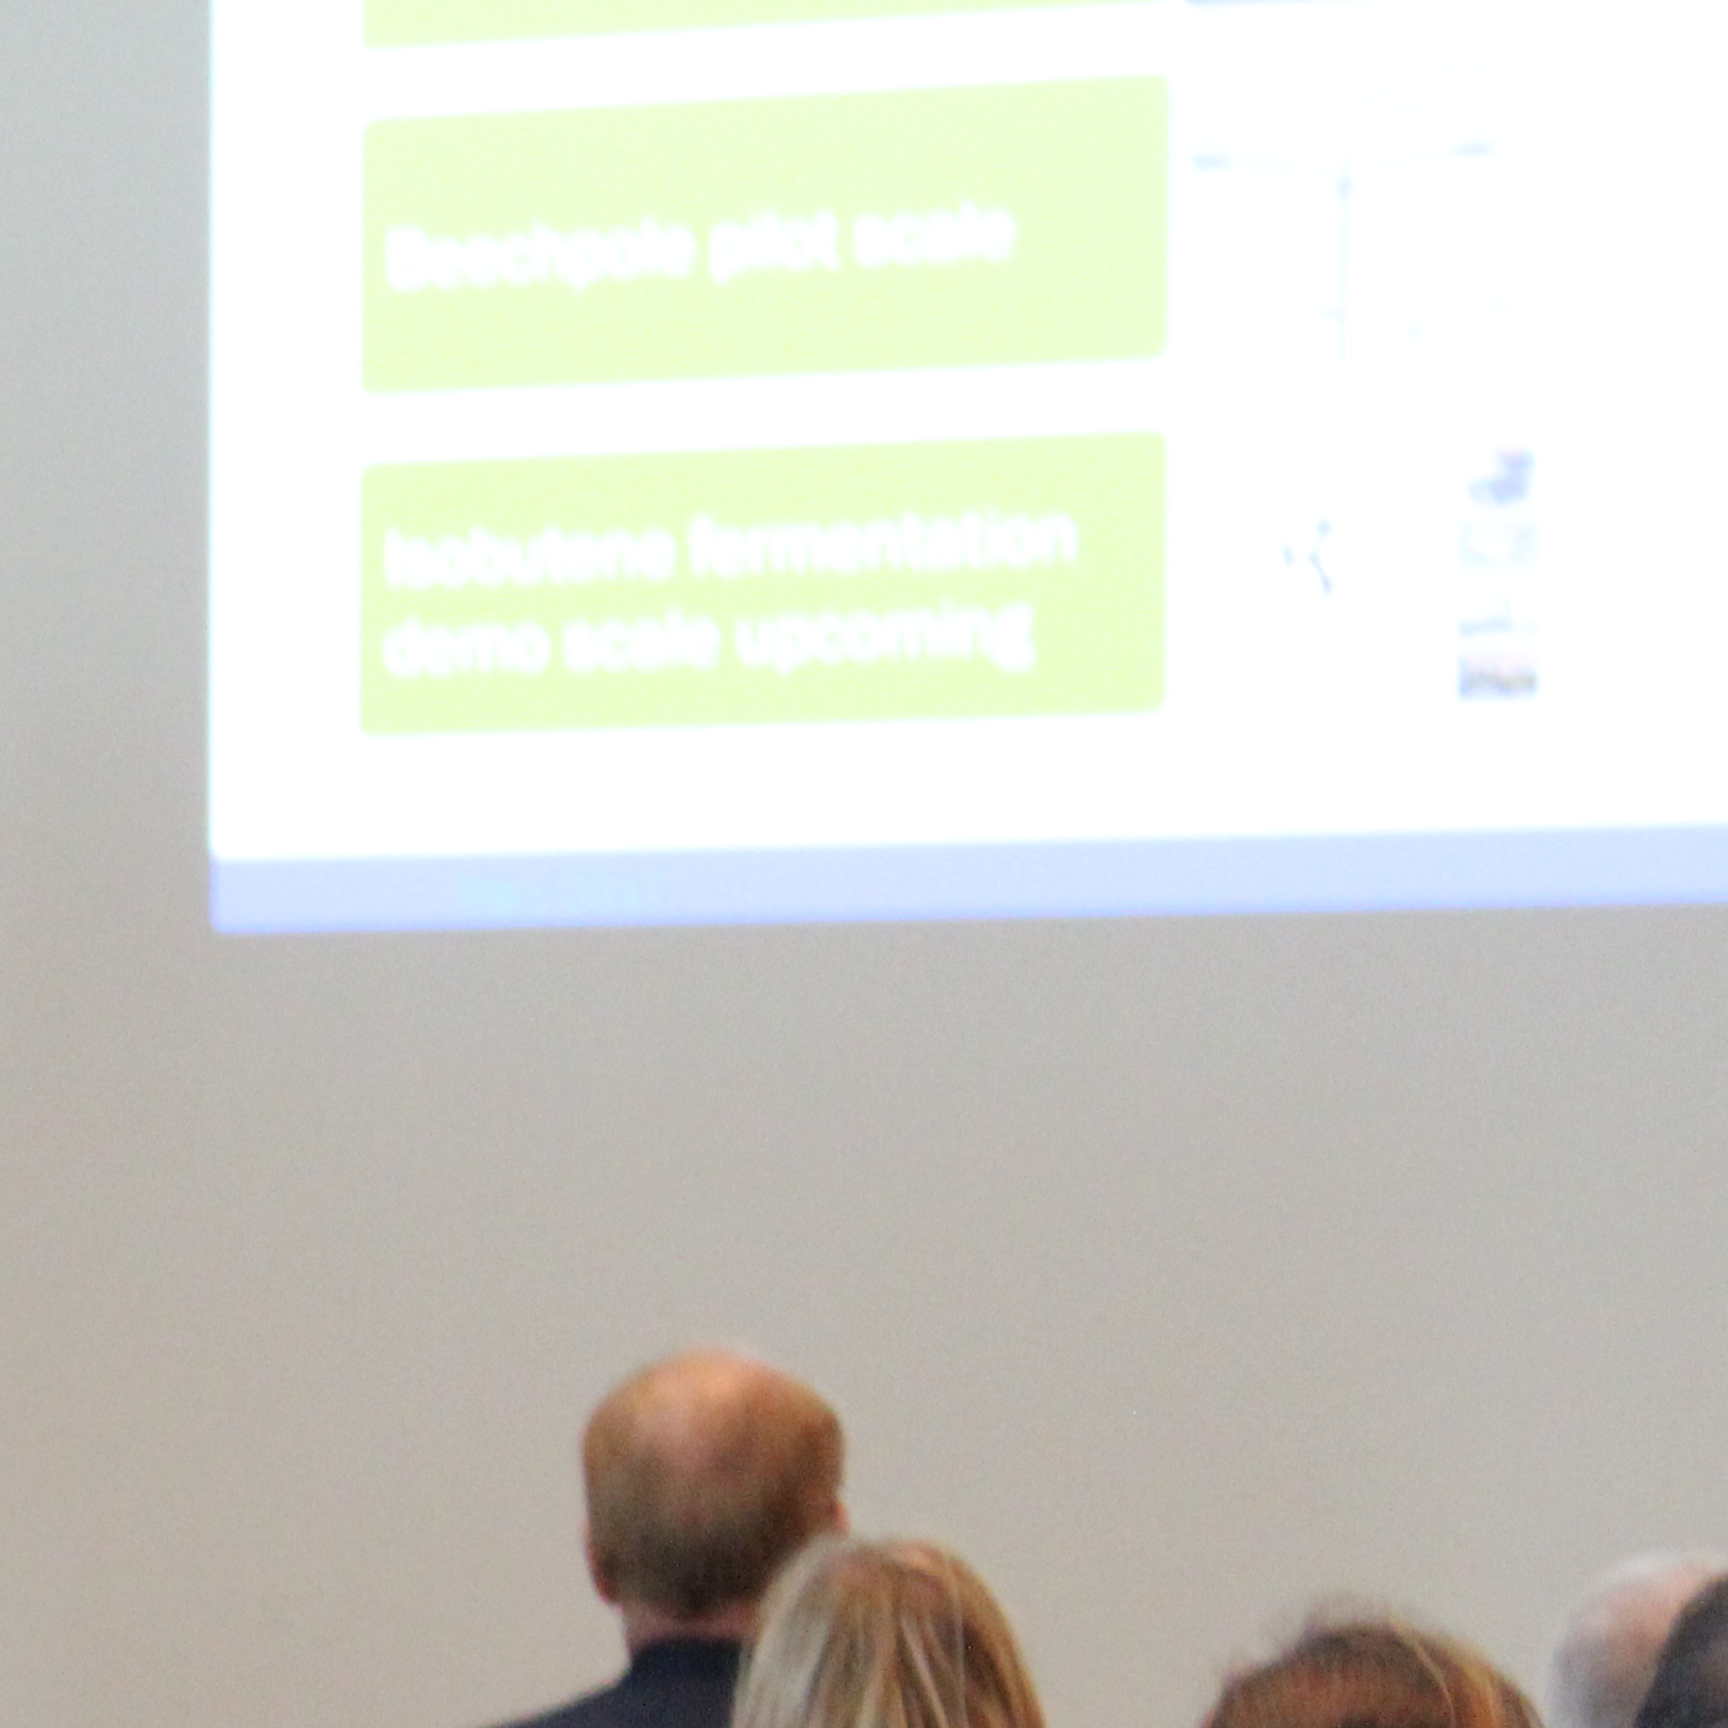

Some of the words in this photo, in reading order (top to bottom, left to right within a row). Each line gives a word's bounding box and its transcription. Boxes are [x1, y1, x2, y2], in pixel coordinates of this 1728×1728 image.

[709, 210, 841, 285] pilot
[852, 199, 1017, 269] scale
[384, 526, 678, 590] Isobutene
[687, 510, 1080, 580] fermentation
[382, 617, 552, 678] demo
[562, 607, 722, 673] scale
[735, 601, 1036, 675] upcoming
